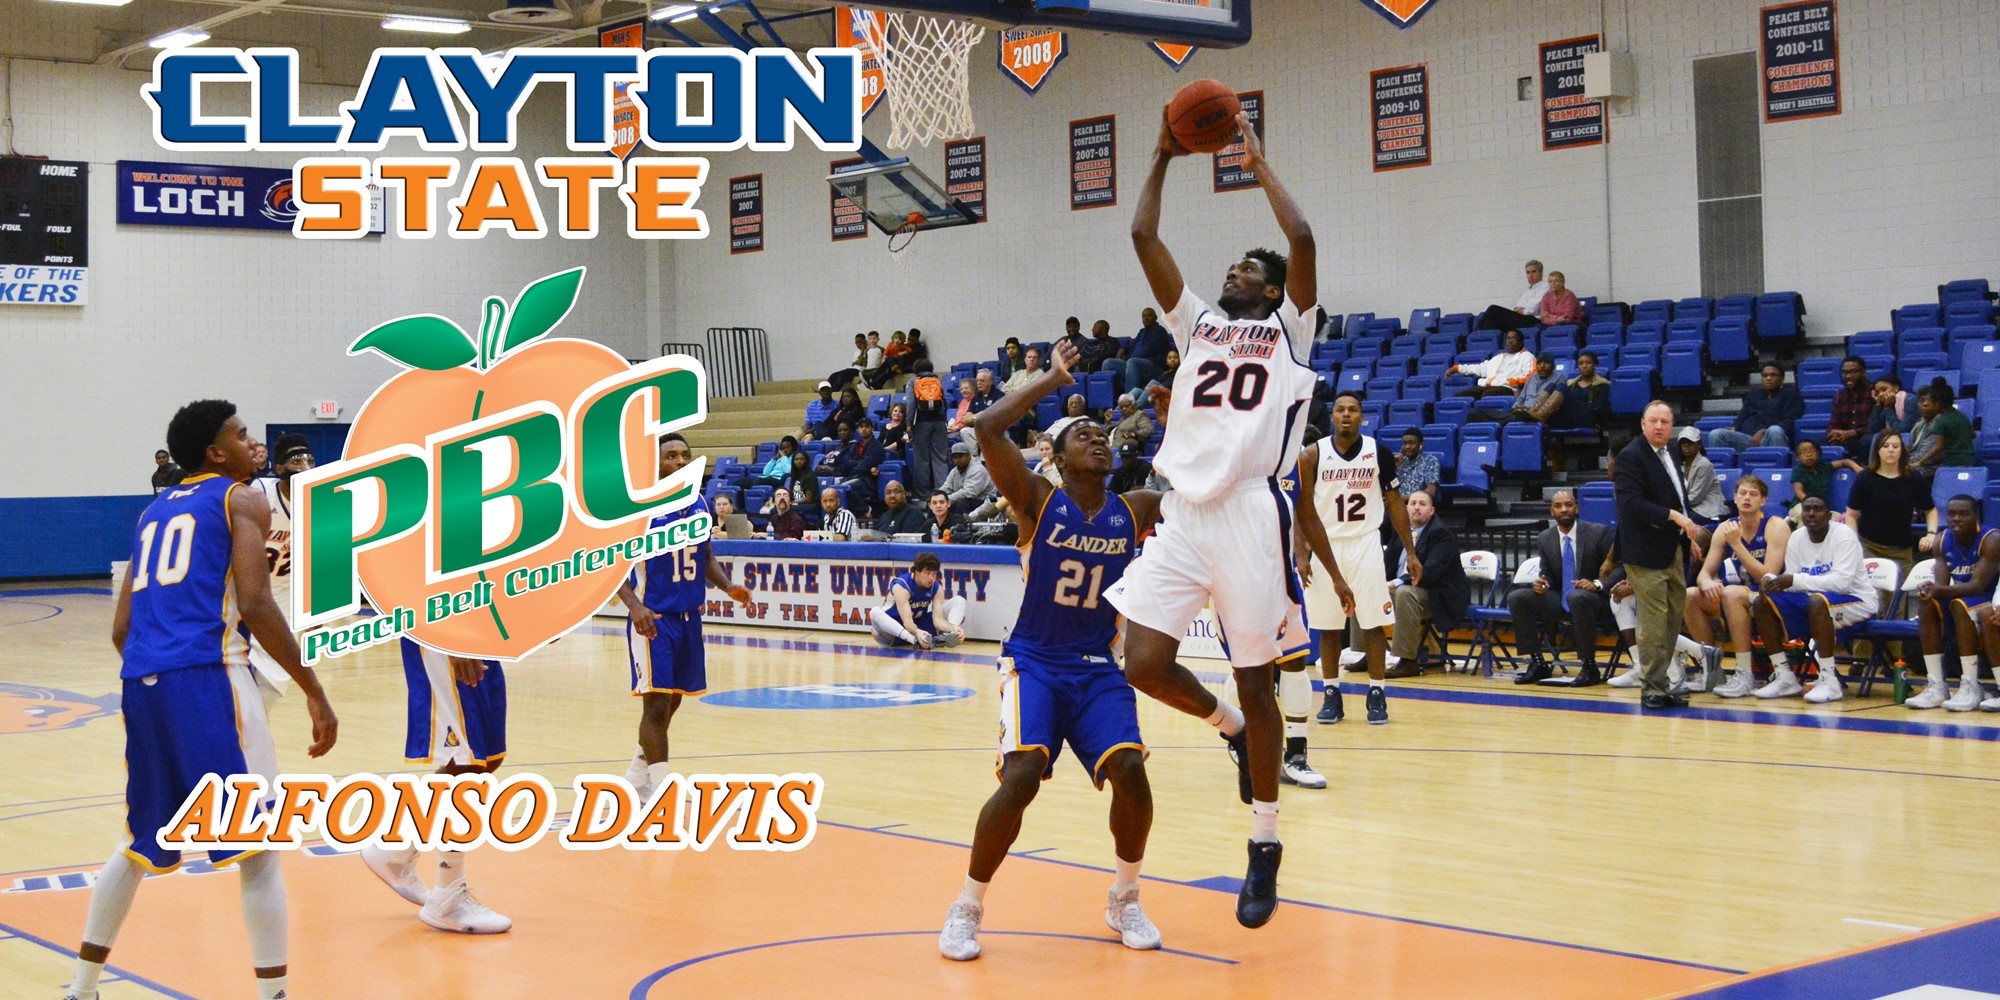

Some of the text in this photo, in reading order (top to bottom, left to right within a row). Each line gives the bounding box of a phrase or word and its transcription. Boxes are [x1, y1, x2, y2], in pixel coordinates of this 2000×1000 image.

[1769, 7, 1828, 25] PEACH BELT
[1768, 21, 1830, 39] CONFERENCE
[1013, 41, 1052, 68] 2008
[1546, 44, 1597, 60] PEACH BELT
[1776, 39, 1824, 57] 2010-11
[1767, 59, 1834, 79] CONFERENCE
[1377, 73, 1421, 88] PEACH BELT
[1771, 74, 1831, 93] CHAMPIONS
[1376, 85, 1423, 100] CONFERENCE
[1380, 100, 1420, 116] 2009-10
[1770, 96, 1835, 110] WOMEN'S BASKETBALL
[1548, 105, 1600, 122] CHAMPIONS
[1378, 114, 1423, 129] CONFERENCE
[1075, 123, 1109, 136] PEACH BELT
[1377, 125, 1425, 140] TOURNAMENT
[1551, 126, 1599, 138] MEN'S SOCCER
[1074, 134, 1111, 146] CONFERENCE
[1381, 136, 1422, 151] CHAMPIONS
[949, 145, 980, 156] PEACH BELT
[1076, 146, 1109, 160] 2007-08
[948, 155, 982, 166] CONFERENCE
[1075, 158, 1110, 171] CONFERENCE
[41, 165, 78, 177] HOME
[949, 167, 980, 179] 2007-08
[1074, 168, 1111, 181] TOURNAMENT
[1223, 174, 1239, 182] MEN'S
[132, 171, 244, 187] WELCOME TO THE
[1077, 178, 1109, 191] CHAMPIONS
[132, 185, 244, 216] LOCH
[952, 192, 982, 203] AMPIONS
[738, 200, 753, 211] 2007
[47, 225, 72, 233] FOULS
[45, 255, 73, 263] POINTS
[14, 267, 39, 279] OF
[48, 268, 85, 280] THE
[0, 283, 79, 303] KERS
[1192, 322, 1281, 346] CLAYTON
[1229, 344, 1275, 359] STATE
[1193, 360, 1269, 411] 20
[321, 402, 335, 414] EXIT
[1322, 467, 1375, 482] CLAYTON
[1335, 493, 1366, 522] 12
[1045, 523, 1127, 554] LANDER
[133, 513, 196, 592] 10
[672, 546, 698, 582] 15
[744, 562, 819, 593] STATE
[829, 564, 990, 602] UNIVITY
[1054, 559, 1104, 609] 21
[746, 602, 769, 619] OF
[780, 603, 818, 622] THE
